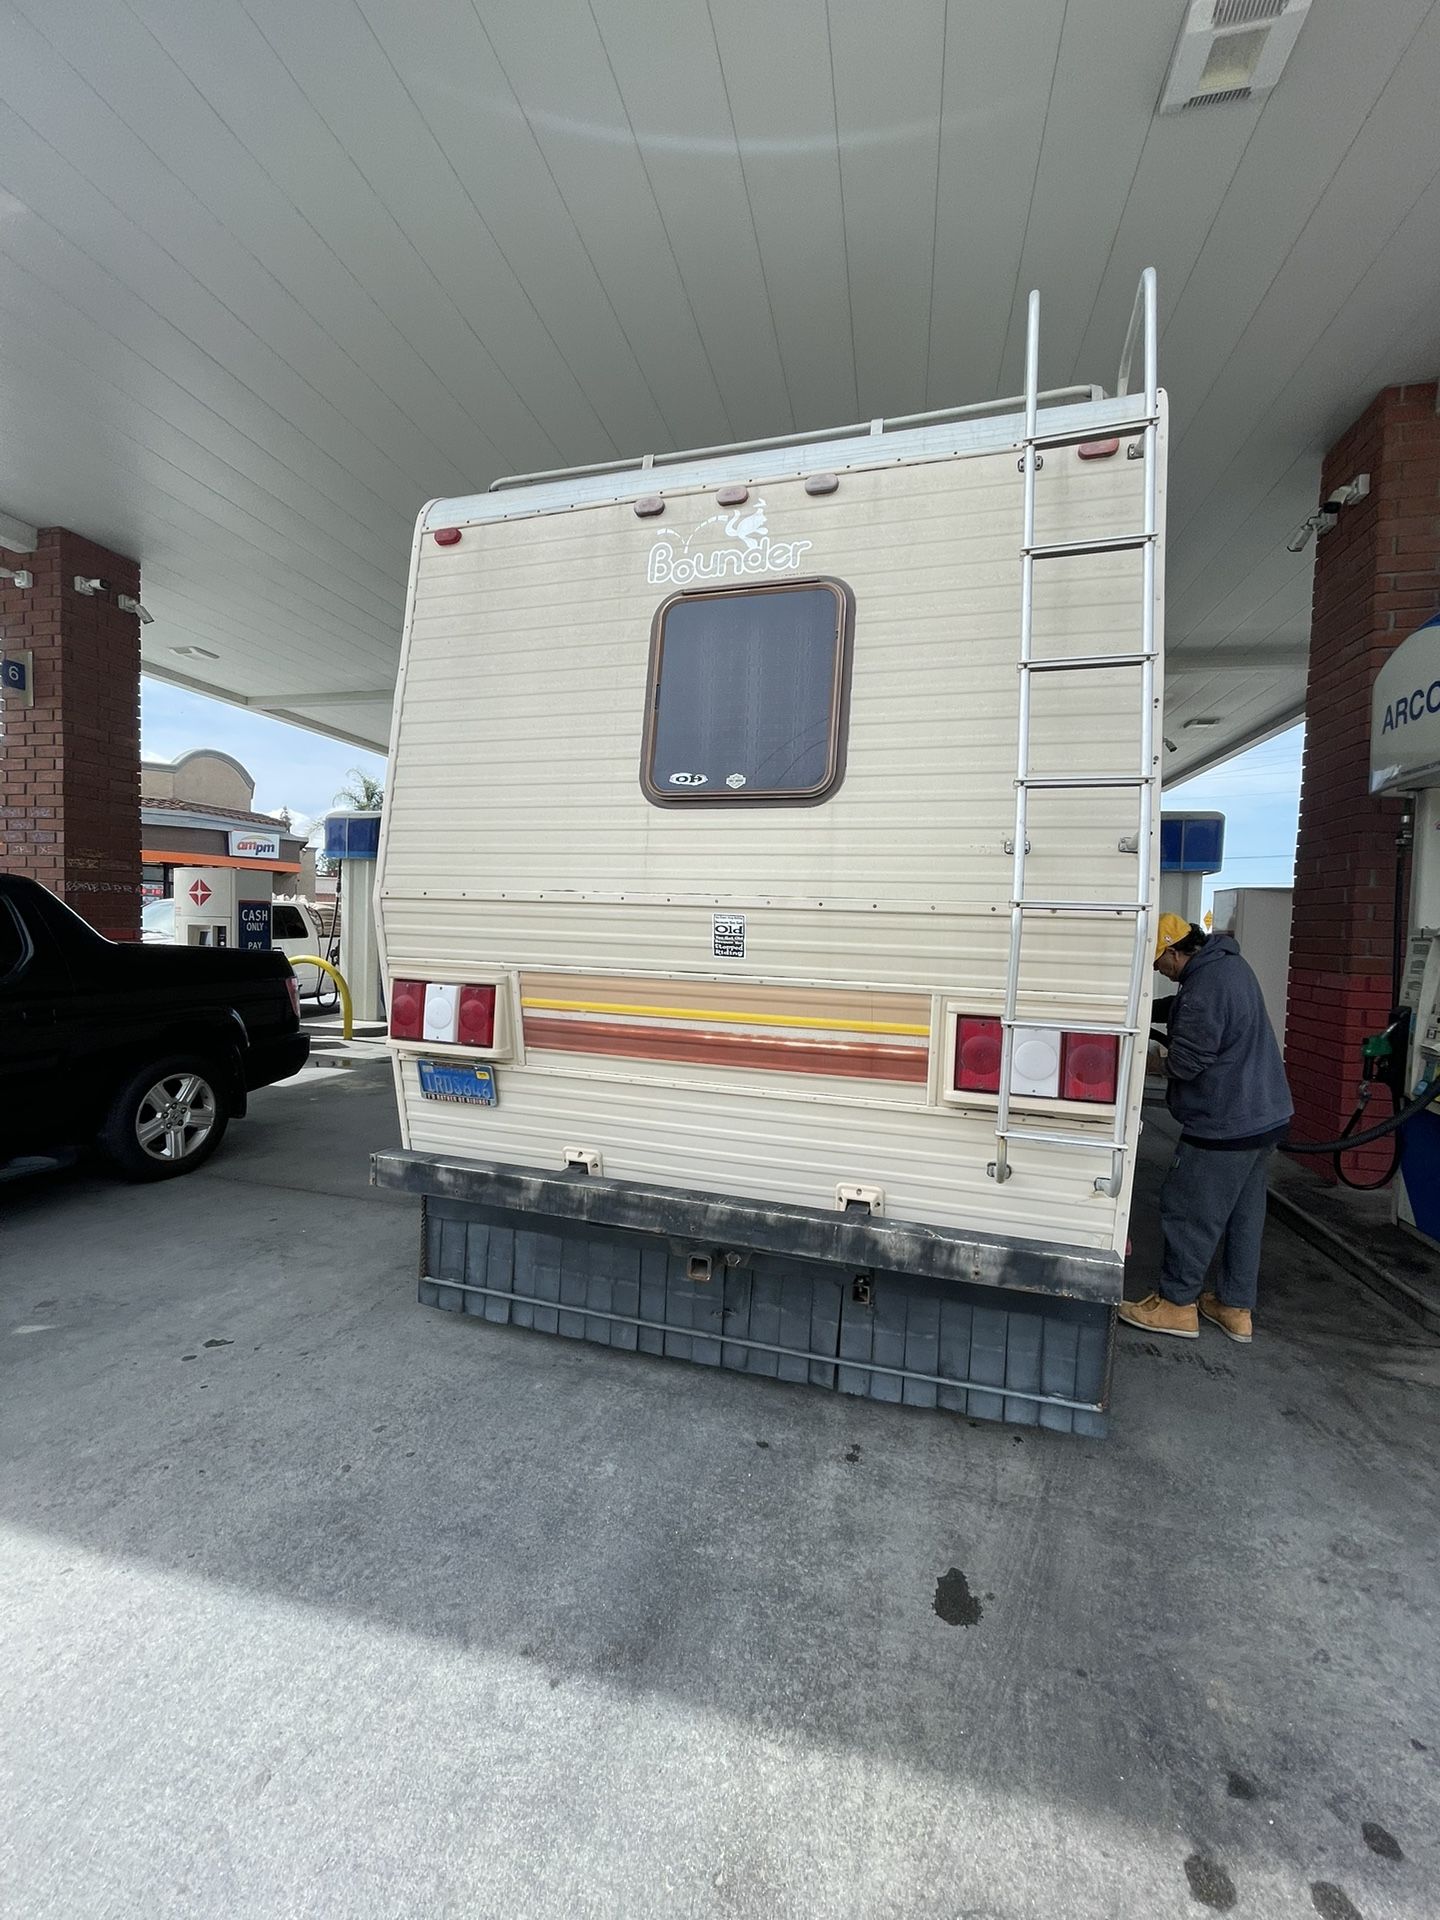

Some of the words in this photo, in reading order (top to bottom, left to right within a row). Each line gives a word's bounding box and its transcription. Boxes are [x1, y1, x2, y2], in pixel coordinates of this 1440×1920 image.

[647, 537, 812, 584] Bounder
[8, 666, 19, 681] 6
[1382, 680, 1440, 735] ARCO
[236, 840, 275, 855] ampm
[242, 909, 268, 921] CASH
[246, 922, 264, 932] ONLY
[715, 925, 743, 934] Old
[248, 941, 263, 950] PAY
[715, 949, 743, 957] Riding
